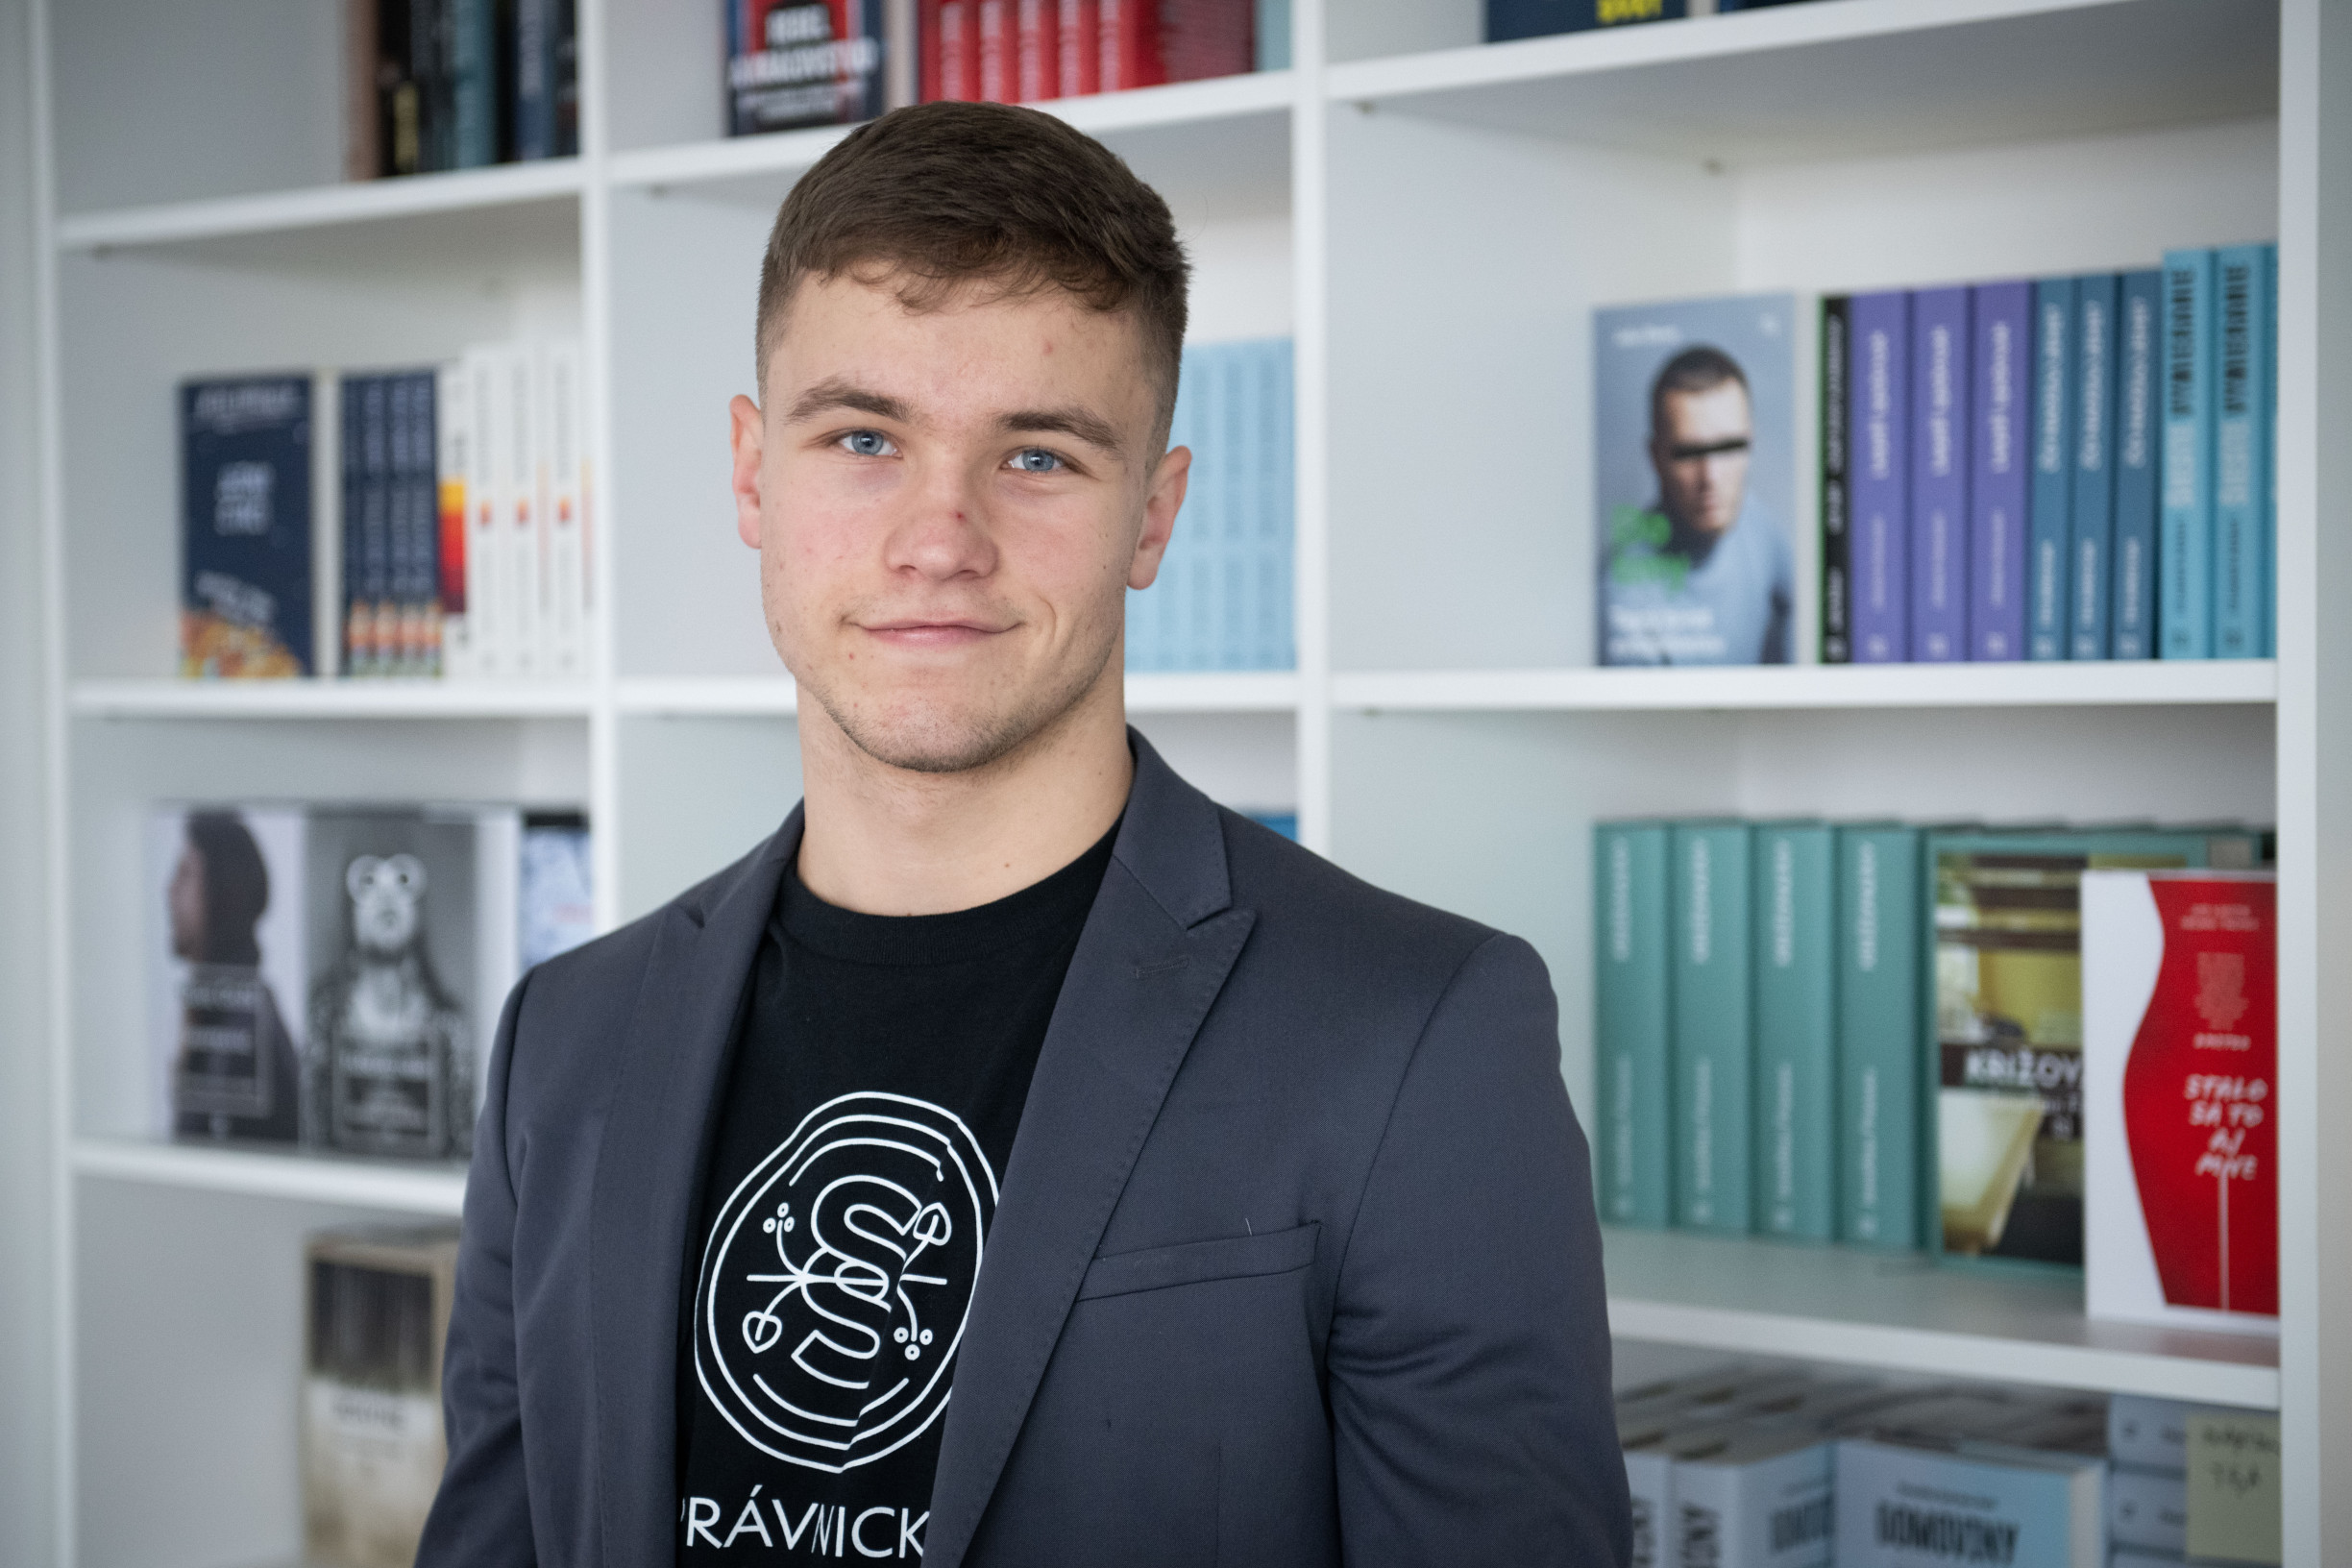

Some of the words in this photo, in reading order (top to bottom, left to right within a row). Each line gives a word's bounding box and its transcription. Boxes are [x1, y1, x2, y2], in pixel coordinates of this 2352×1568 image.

[1966, 1045, 2082, 1088] KRIŽOV
[2184, 1073, 2268, 1102] STALO
[680, 1484, 930, 1558] RÁVNICK
